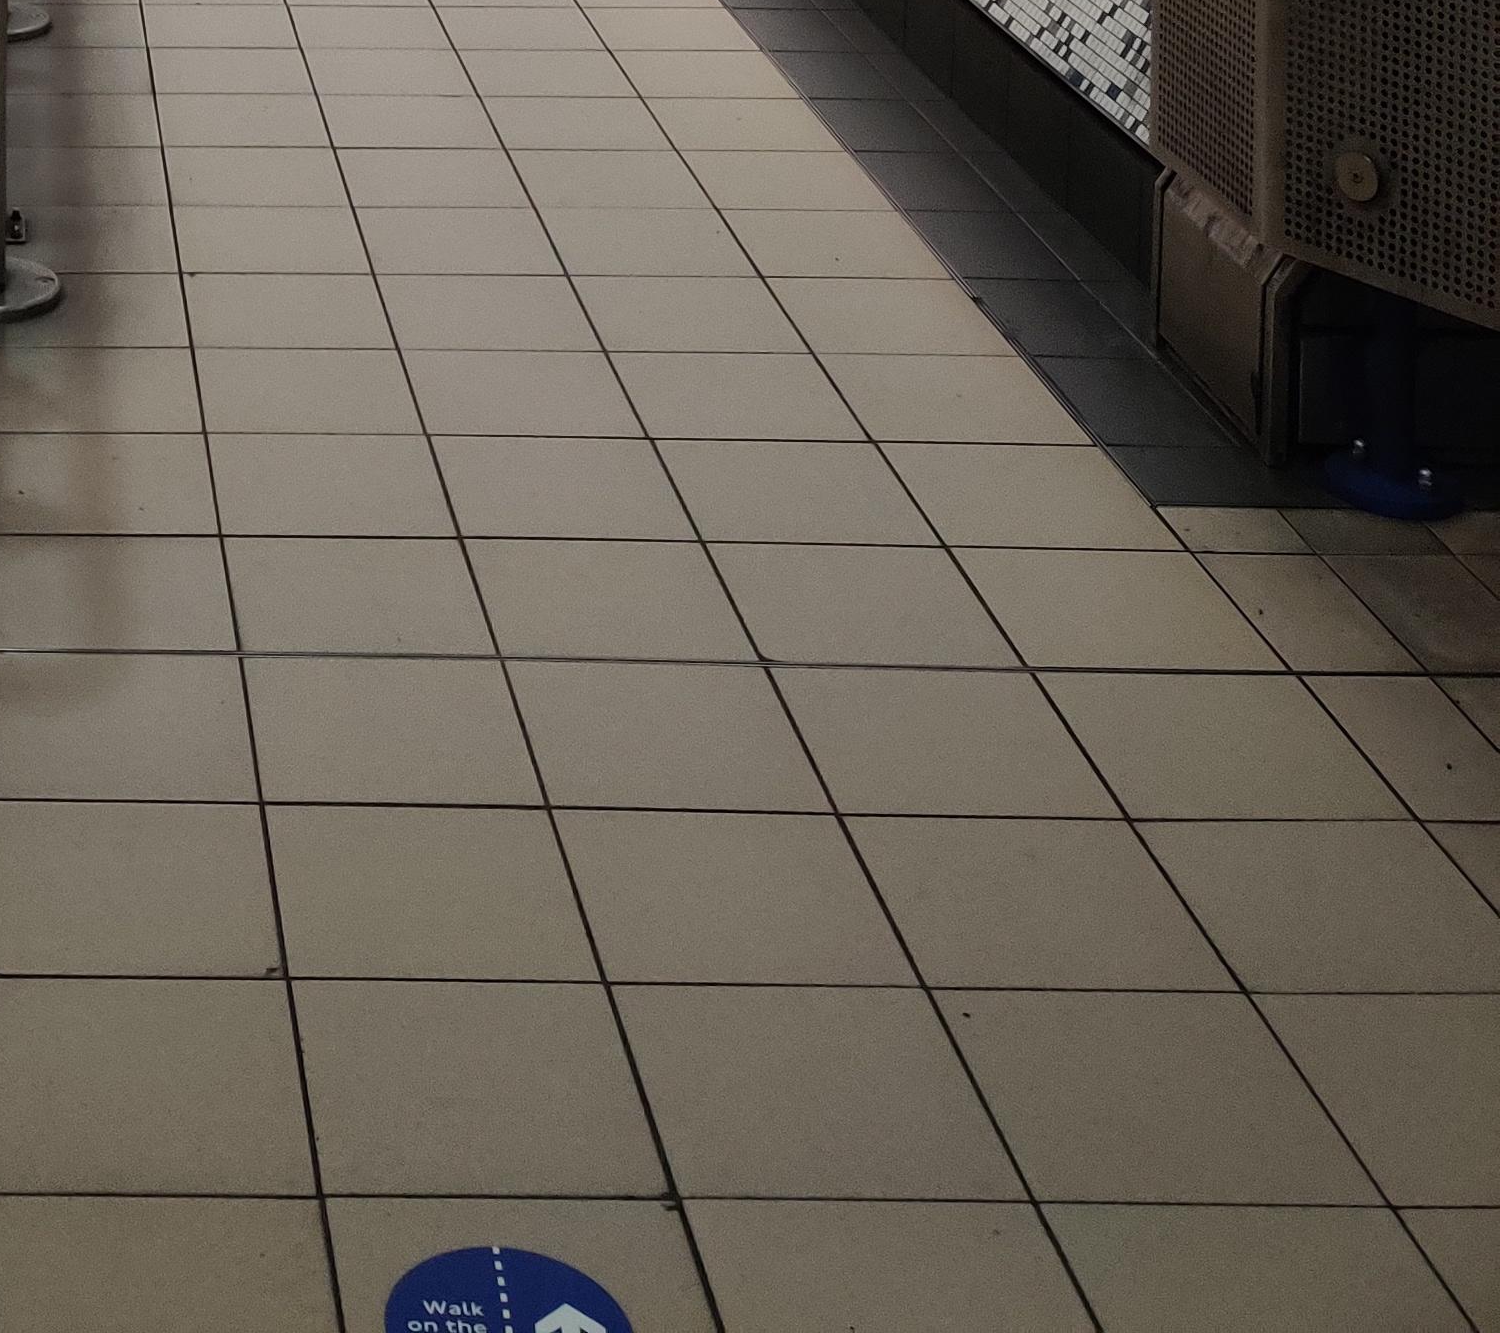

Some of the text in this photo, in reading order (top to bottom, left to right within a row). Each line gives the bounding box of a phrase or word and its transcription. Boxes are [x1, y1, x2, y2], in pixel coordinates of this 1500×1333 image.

[422, 1299, 485, 1317] Walk
[407, 1318, 487, 1333] on the
